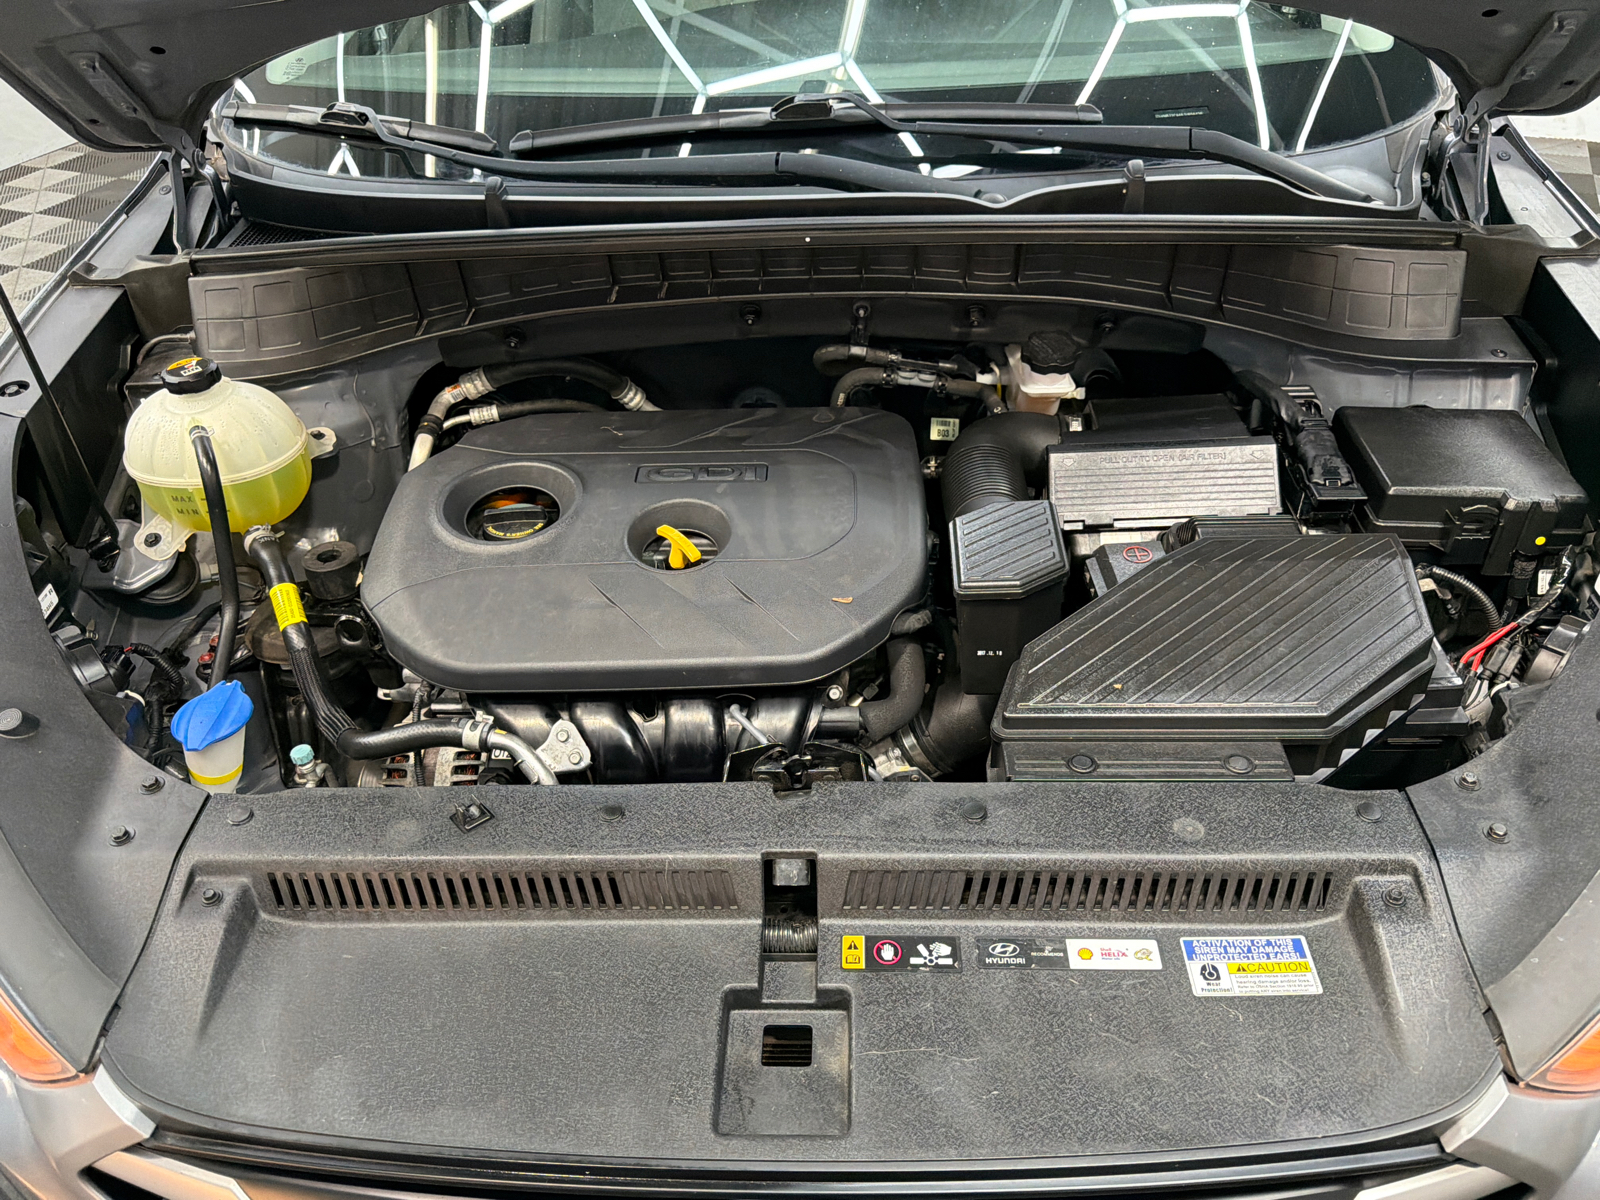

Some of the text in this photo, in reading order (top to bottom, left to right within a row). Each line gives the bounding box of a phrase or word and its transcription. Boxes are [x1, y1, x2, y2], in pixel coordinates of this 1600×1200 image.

[937, 429, 950, 438] B03
[1100, 456, 1120, 464] PULL
[1139, 455, 1151, 463] TO
[1153, 454, 1175, 462] OPEN
[646, 466, 760, 481] GDI
[171, 495, 193, 503] MAX
[1192, 939, 1252, 947] ACTIVATION
[1271, 938, 1293, 946] THIS
[1194, 946, 1225, 954] SIREN
[1251, 945, 1294, 953] DAMAGE
[985, 957, 1026, 965] HYUNDAI
[1193, 952, 1300, 961] UNPROTECTED EARS!
[1247, 962, 1309, 973] CAUTION
